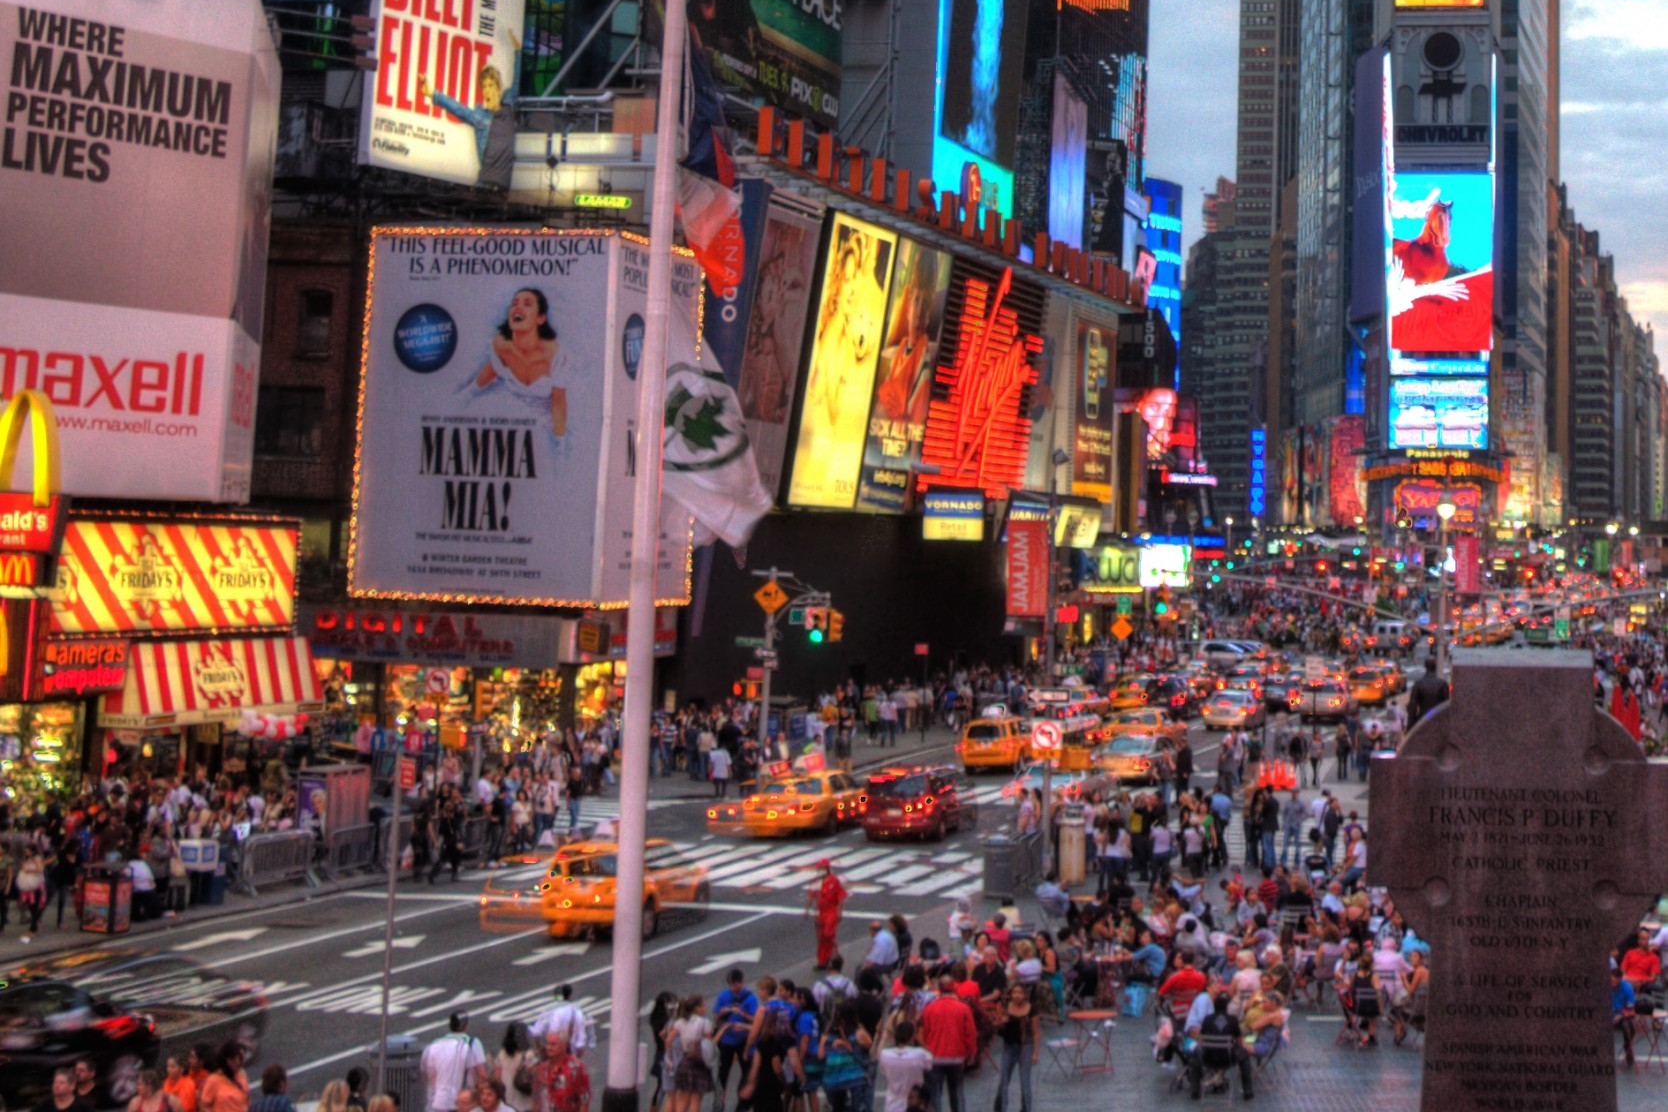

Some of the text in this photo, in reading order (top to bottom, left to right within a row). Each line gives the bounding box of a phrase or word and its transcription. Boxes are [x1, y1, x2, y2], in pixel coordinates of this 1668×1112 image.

[18, 6, 125, 58] WHERE
[478, 14, 496, 38] THE
[375, 13, 493, 125] ELLIOT
[10, 40, 232, 126] MAXIMUM
[6, 90, 228, 159] PERFORMANCE
[1398, 125, 1488, 143] CHEVROLET
[1, 126, 112, 184] LIVES
[432, 237, 525, 256] FEEL-GOOD
[531, 238, 606, 256] MUSICAL
[409, 257, 424, 274] IS
[427, 257, 442, 274] A
[0, 345, 205, 417] maxell
[55, 415, 198, 438] ww.maxell.com
[419, 426, 537, 479] MAMMA
[1405, 448, 1470, 459] Panasonic
[440, 480, 512, 532] MIA!
[924, 499, 984, 512] VORNADO
[0, 510, 48, 533] ald's
[940, 521, 967, 533] Retail
[121, 570, 173, 589] FRIDAY'S
[219, 572, 266, 589] FRIDAY'S
[1011, 530, 1030, 612] JAMJAM
[315, 609, 484, 638] DIGITAL
[1531, 789, 1603, 805] COLONEL
[1429, 806, 1617, 829] FRANCIS P DUFFY
[1452, 855, 1590, 873] CATHOLIC PRIEST
[1484, 893, 1559, 909] CHAPLAIN
[1504, 974, 1525, 988] OF
[1530, 975, 1591, 989] SERVICE
[1445, 1003, 1597, 1021] GOD AND COUNTRY
[1569, 1044, 1599, 1058] WAR
[1499, 1061, 1564, 1076] NATIONAL
[1567, 1063, 1615, 1077] GUARD
